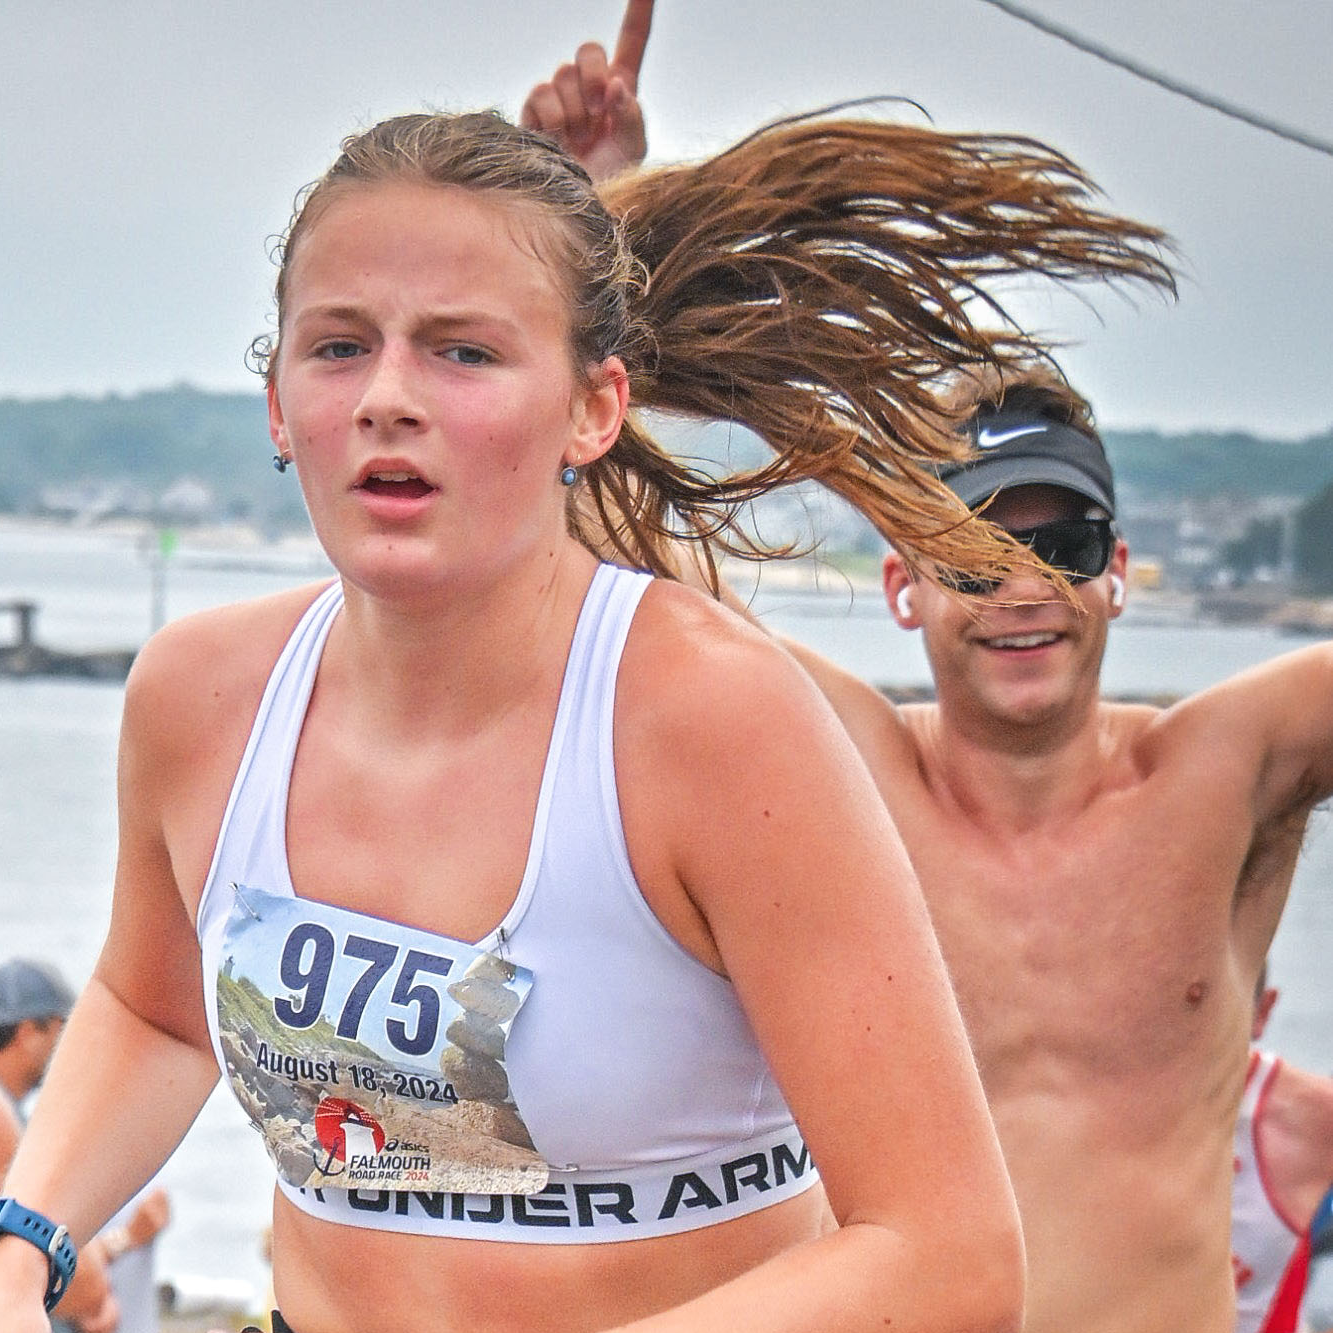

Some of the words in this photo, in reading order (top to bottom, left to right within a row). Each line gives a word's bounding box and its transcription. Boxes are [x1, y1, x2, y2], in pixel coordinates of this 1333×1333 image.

[273, 922, 454, 1057] 975
[256, 1042, 339, 1084] August
[348, 1064, 386, 1098] 18,
[393, 1073, 459, 1104] 2024
[400, 1143, 430, 1153] asics
[349, 1155, 431, 1171] FALMOUTH
[348, 1170, 376, 1180] ROAD
[378, 1171, 402, 1181] RACE
[404, 1171, 430, 1182] 2024
